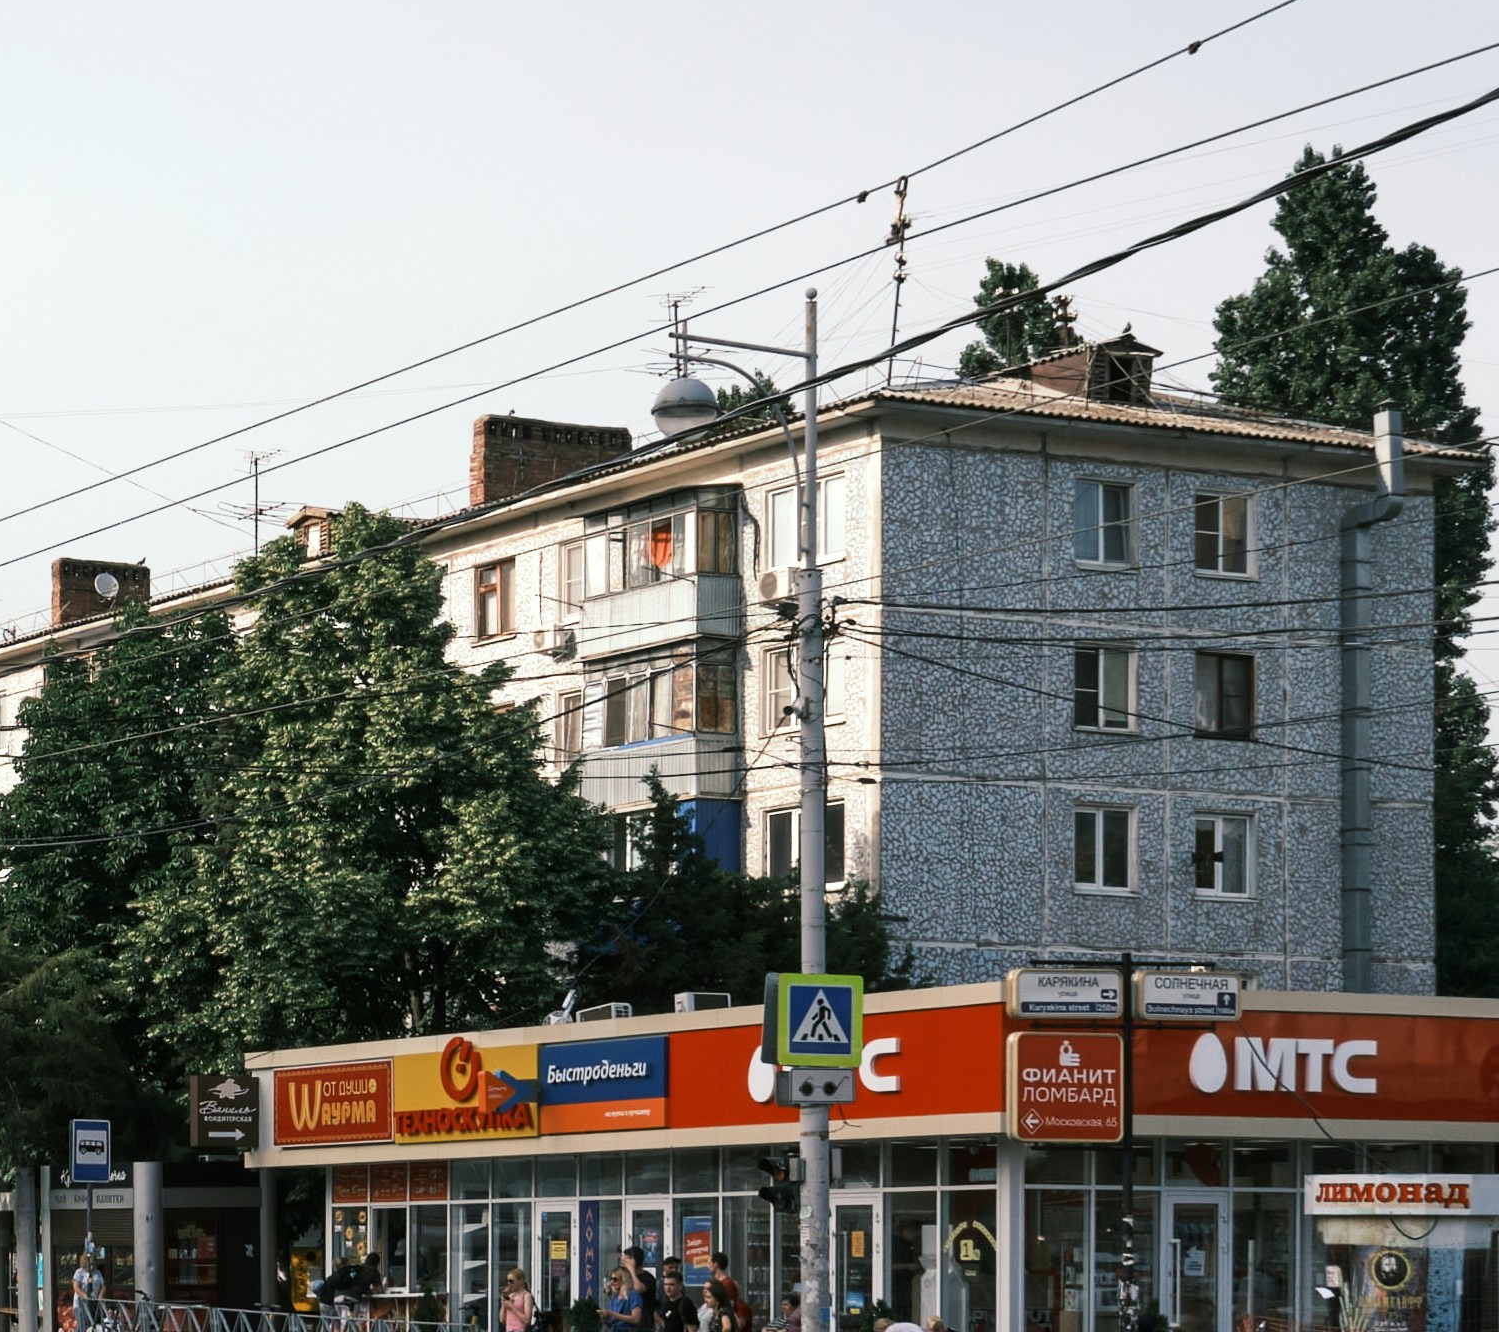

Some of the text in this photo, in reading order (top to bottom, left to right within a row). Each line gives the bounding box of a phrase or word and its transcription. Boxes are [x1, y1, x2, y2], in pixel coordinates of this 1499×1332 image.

[1037, 976, 1100, 988] КАРЯКИНА
[1154, 977, 1229, 990] СОЛНЕЧНАЯ
[547, 1059, 647, 1086] Быстроденьги
[1234, 1036, 1378, 1094] МТС
[1022, 1067, 1116, 1085] ФИАНИТ
[1022, 1086, 1117, 1107] ЛОМБАРД
